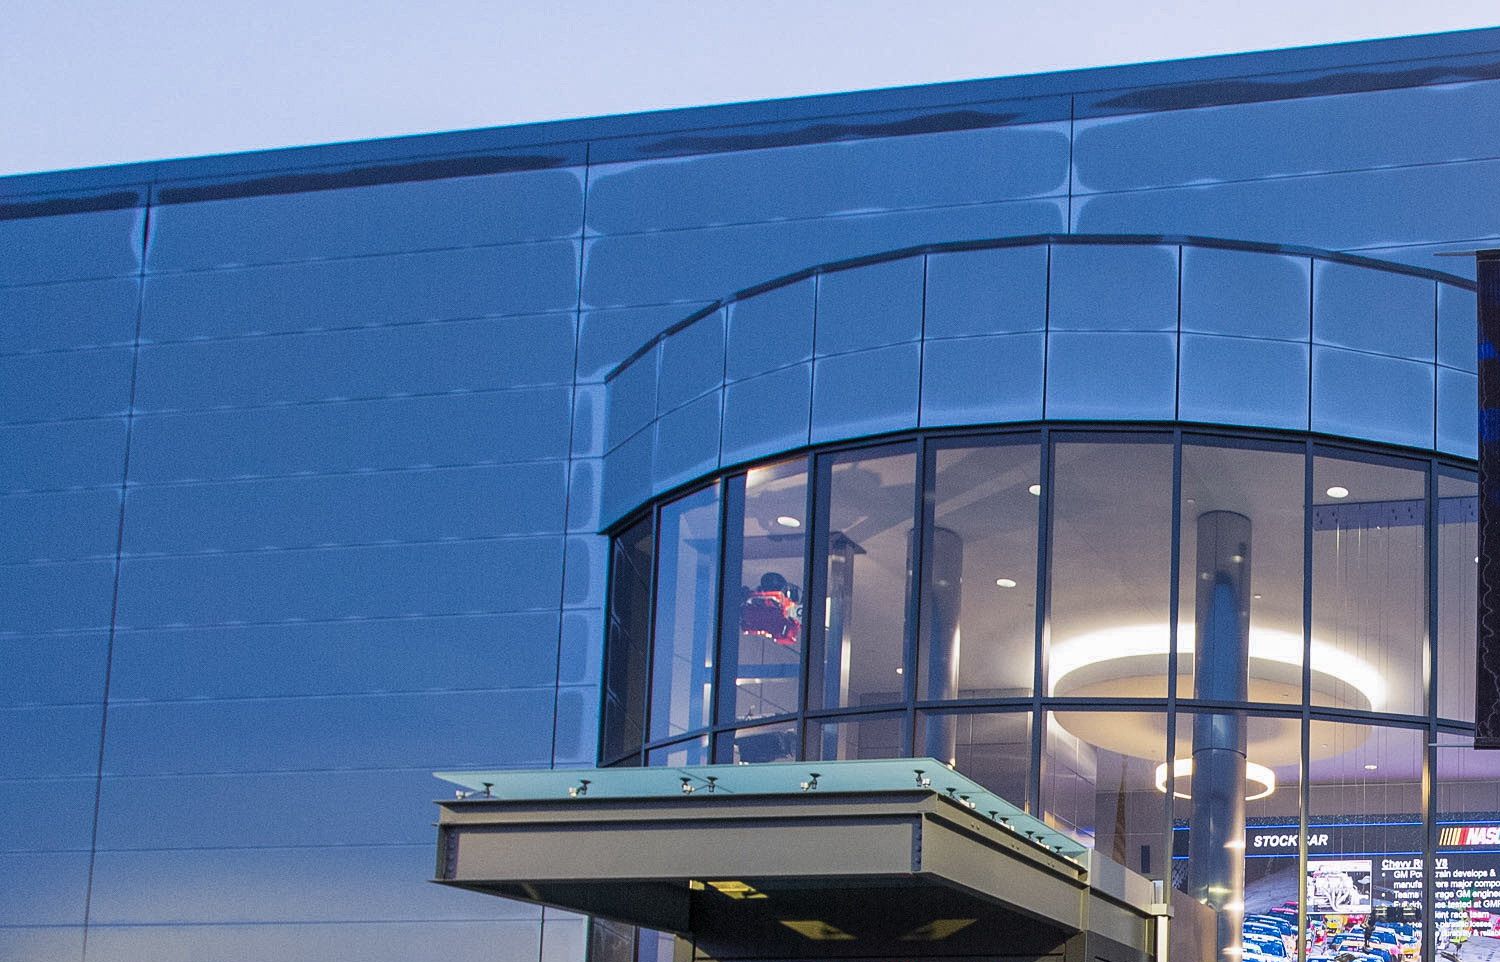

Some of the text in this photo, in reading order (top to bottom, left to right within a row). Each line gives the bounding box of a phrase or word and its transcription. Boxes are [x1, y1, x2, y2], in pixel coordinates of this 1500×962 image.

[1253, 834, 1298, 847] STOCK
[1381, 859, 1412, 870] Chevy
[1435, 858, 1449, 869] V8
[1394, 870, 1409, 879] GM
[1453, 868, 1488, 879] develops
[1489, 868, 1497, 877] &
[1450, 879, 1473, 889] major
[1395, 890, 1419, 898] Teams
[1456, 889, 1471, 898] GM
